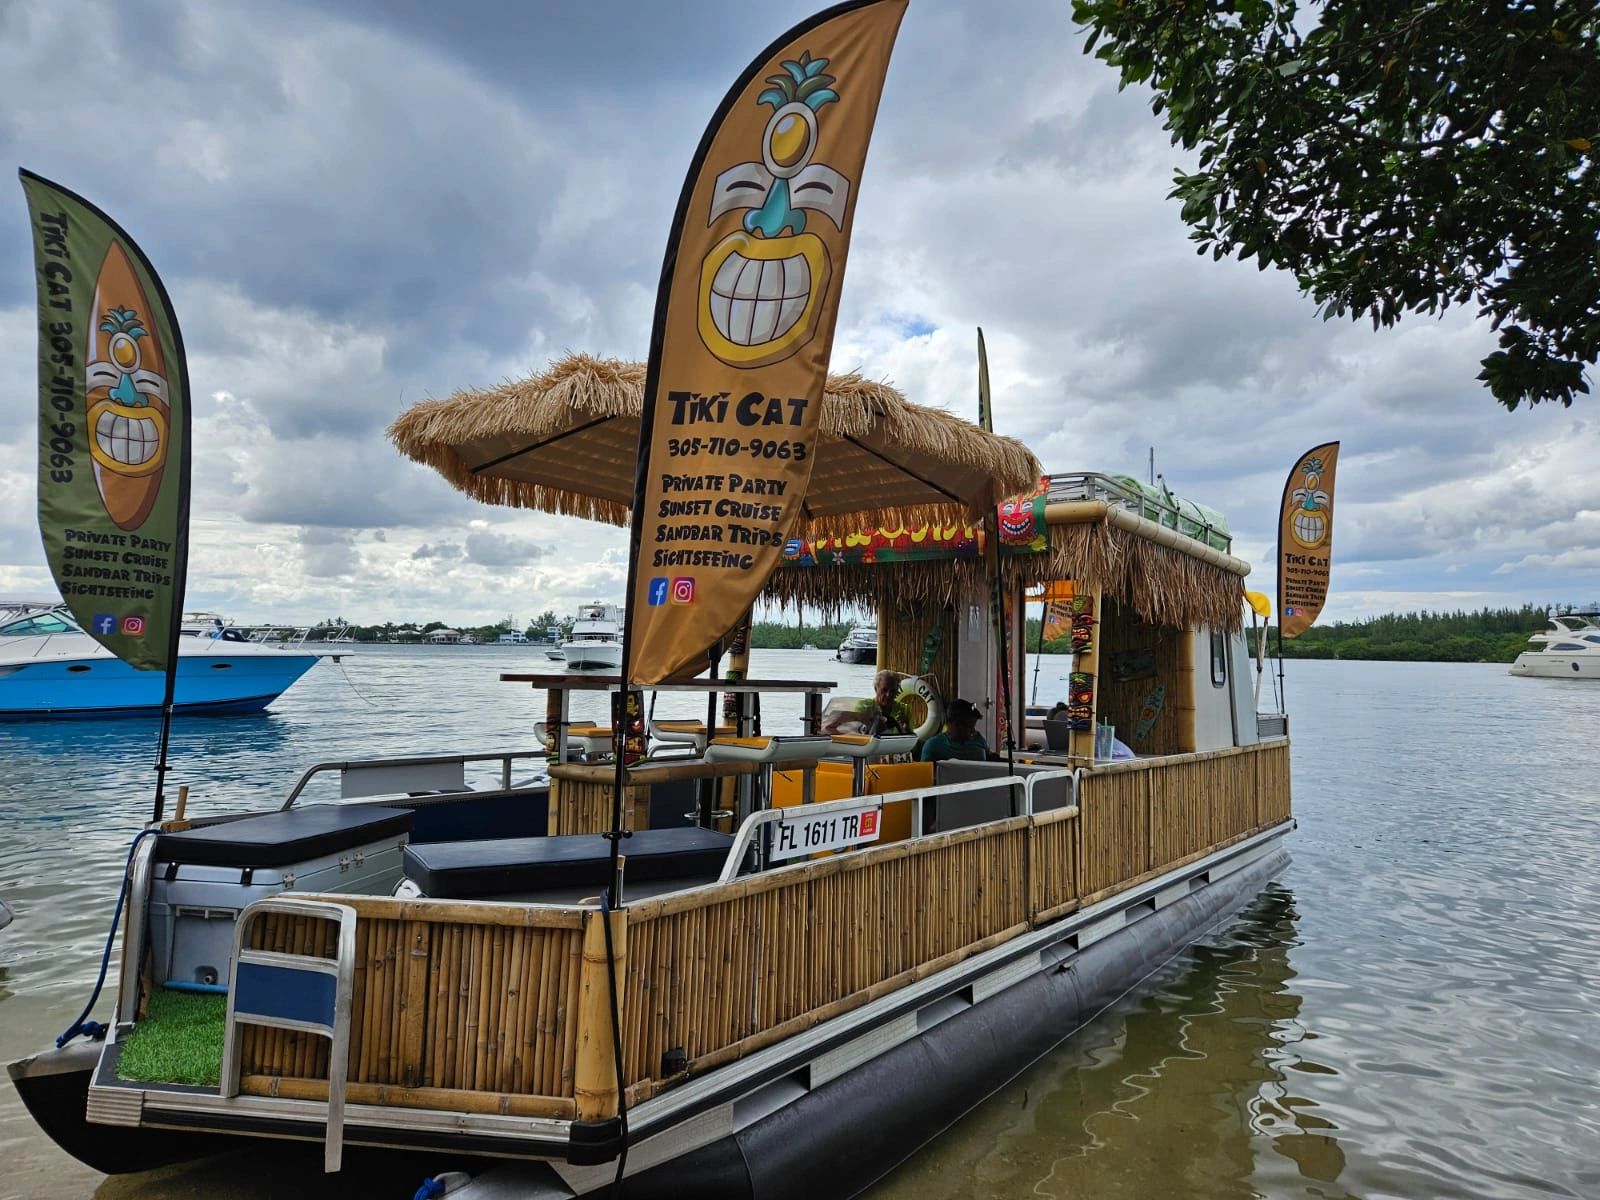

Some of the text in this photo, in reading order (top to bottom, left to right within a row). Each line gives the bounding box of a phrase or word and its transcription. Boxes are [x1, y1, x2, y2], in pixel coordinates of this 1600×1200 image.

[41, 211, 75, 484] TIKI CAT 305-710-9063
[668, 391, 808, 426] TIKI CAT
[668, 437, 806, 461] 305-710-9063
[662, 473, 787, 496] PRIVATE PARTY
[658, 499, 782, 521] SUNSET CRUISE
[64, 529, 172, 553] PRIVATE PARTY
[655, 524, 783, 547] SANDBAR TRIPS
[63, 545, 168, 569] SUNSET CRUISE
[1308, 556, 1329, 567] CAT
[61, 563, 171, 586] SANDBAR TRIPS
[918, 685, 935, 703] CAT
[779, 815, 859, 851] FL 1611 TR
